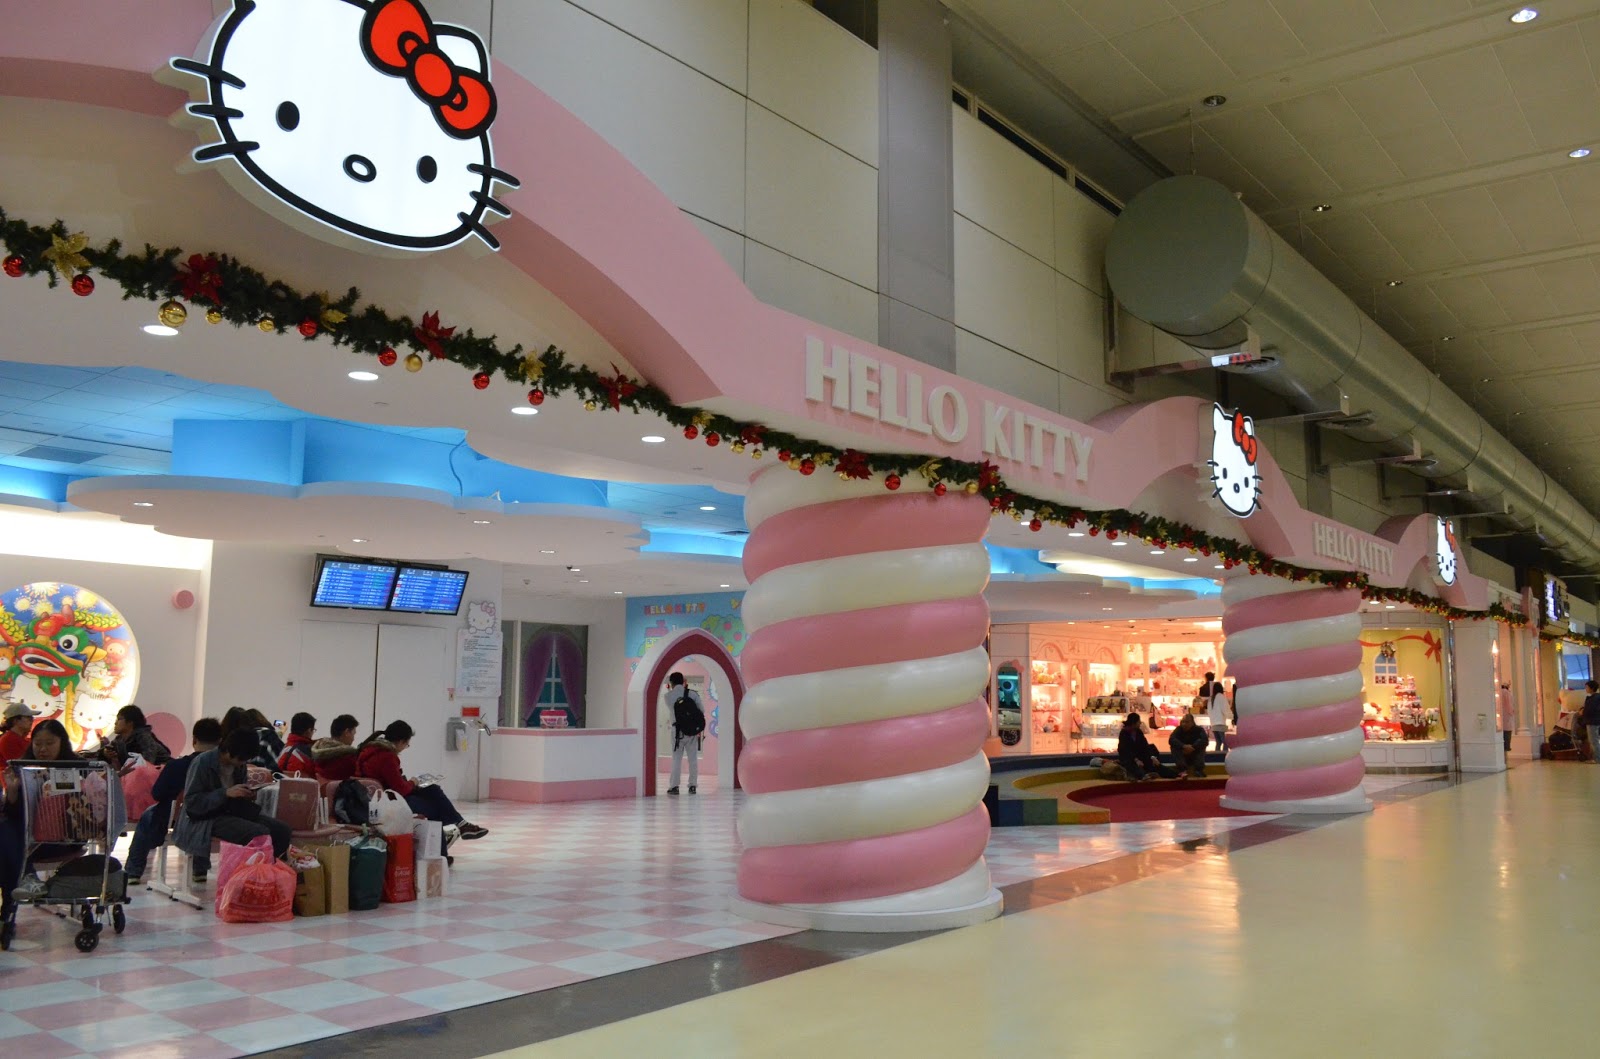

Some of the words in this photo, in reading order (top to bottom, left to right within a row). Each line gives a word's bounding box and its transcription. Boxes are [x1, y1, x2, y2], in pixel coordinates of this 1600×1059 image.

[804, 335, 968, 443] HELLO
[982, 399, 1094, 482] KITTY
[1312, 521, 1357, 564] HELLO
[1358, 537, 1394, 576] KITTY
